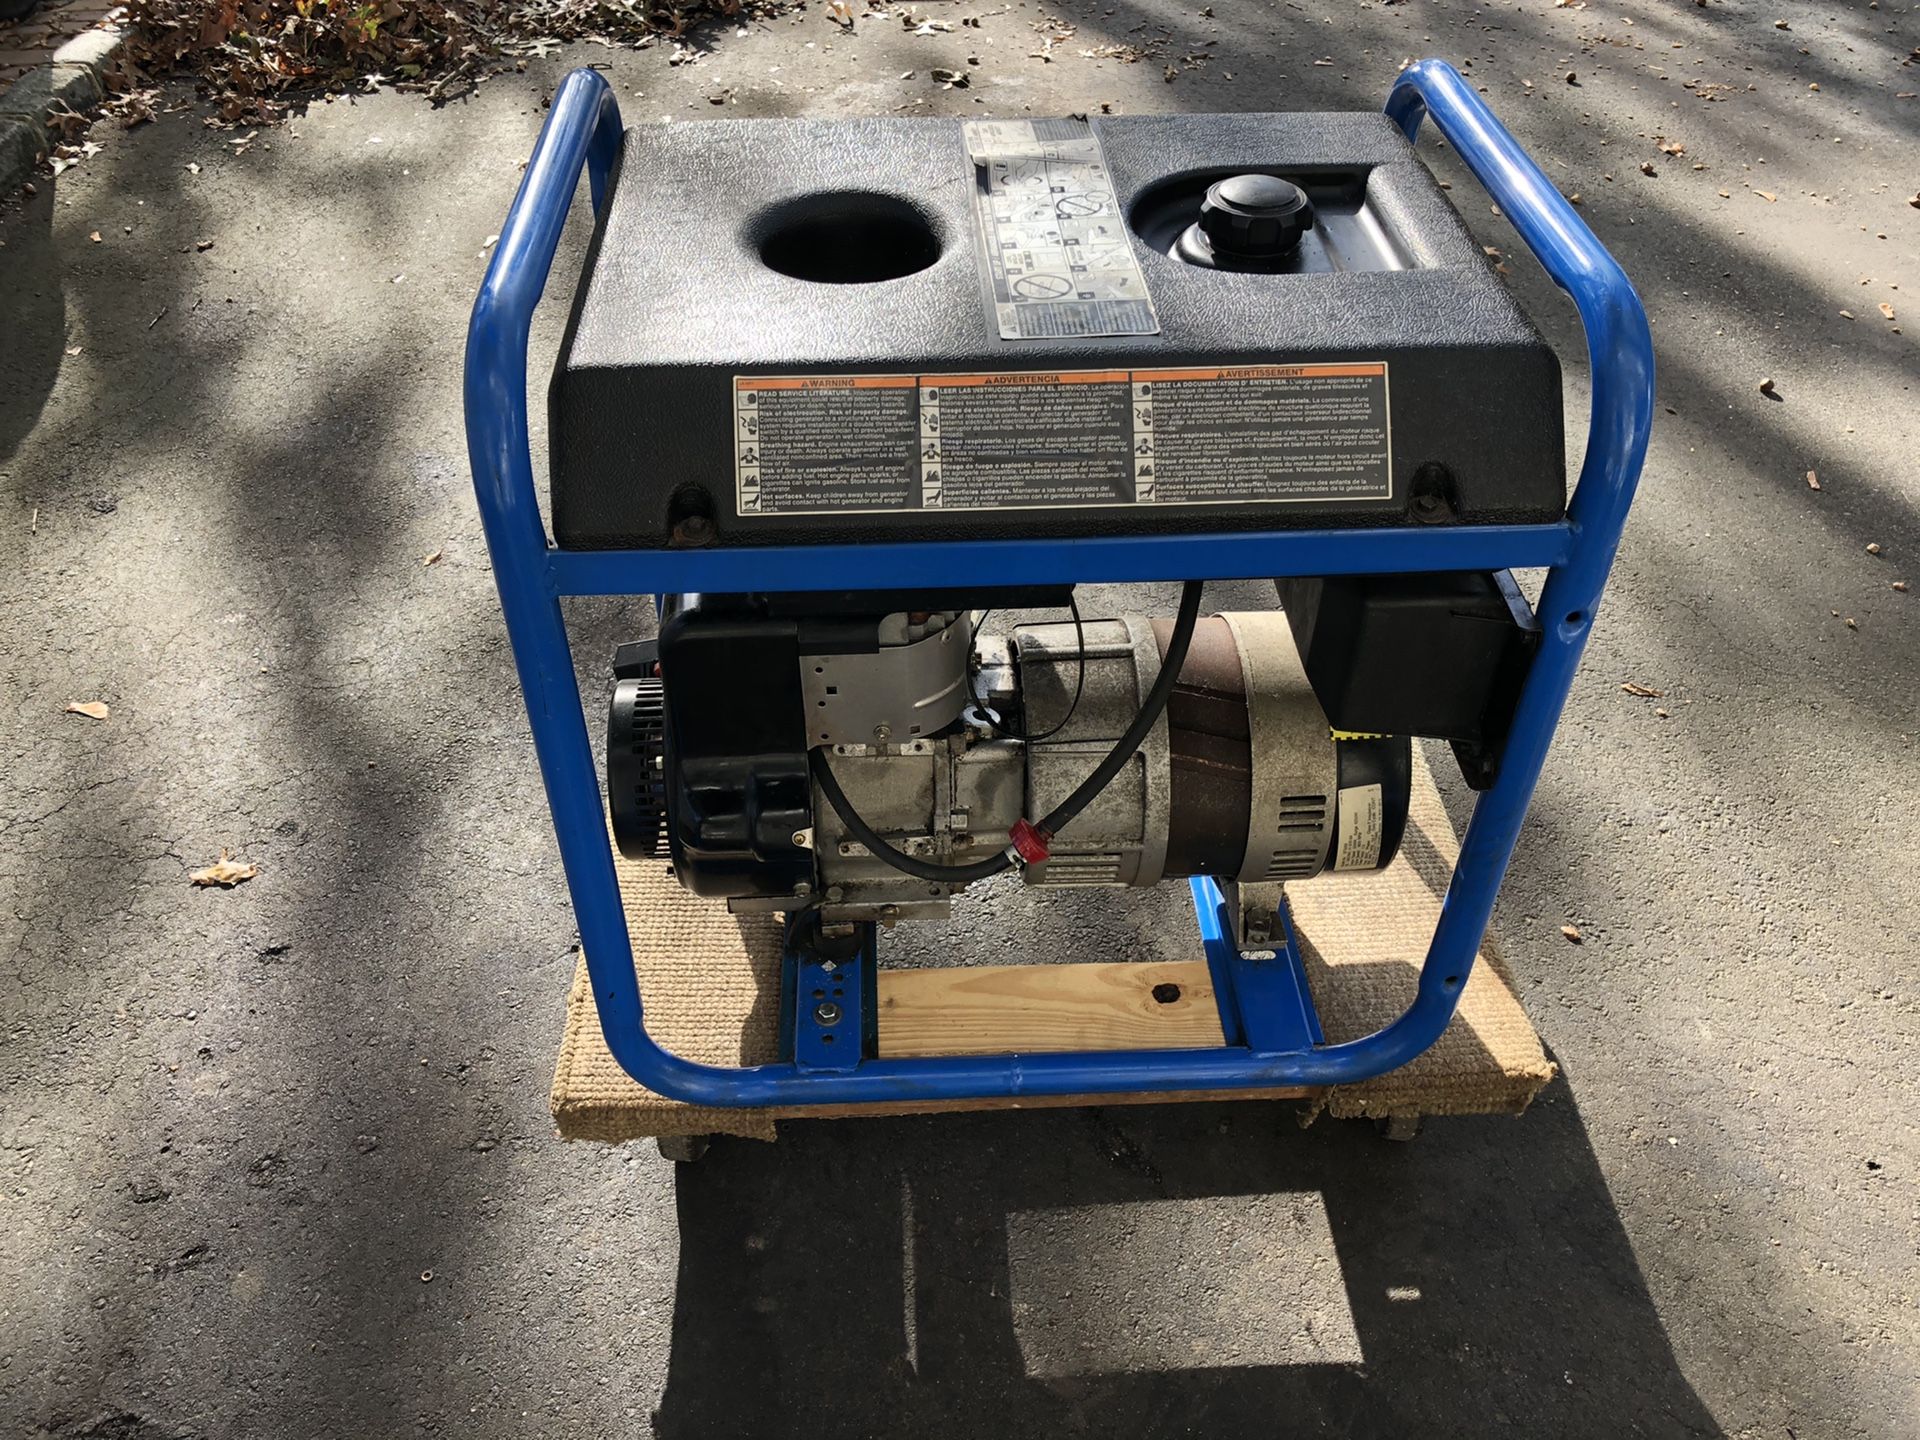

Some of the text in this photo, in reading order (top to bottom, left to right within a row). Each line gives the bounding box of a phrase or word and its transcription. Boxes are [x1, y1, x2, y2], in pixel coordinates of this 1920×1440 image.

[1226, 368, 1304, 378] AVERTISSEMENT
[809, 380, 855, 388] WARNING
[994, 376, 1060, 384] ADVERTENCIA
